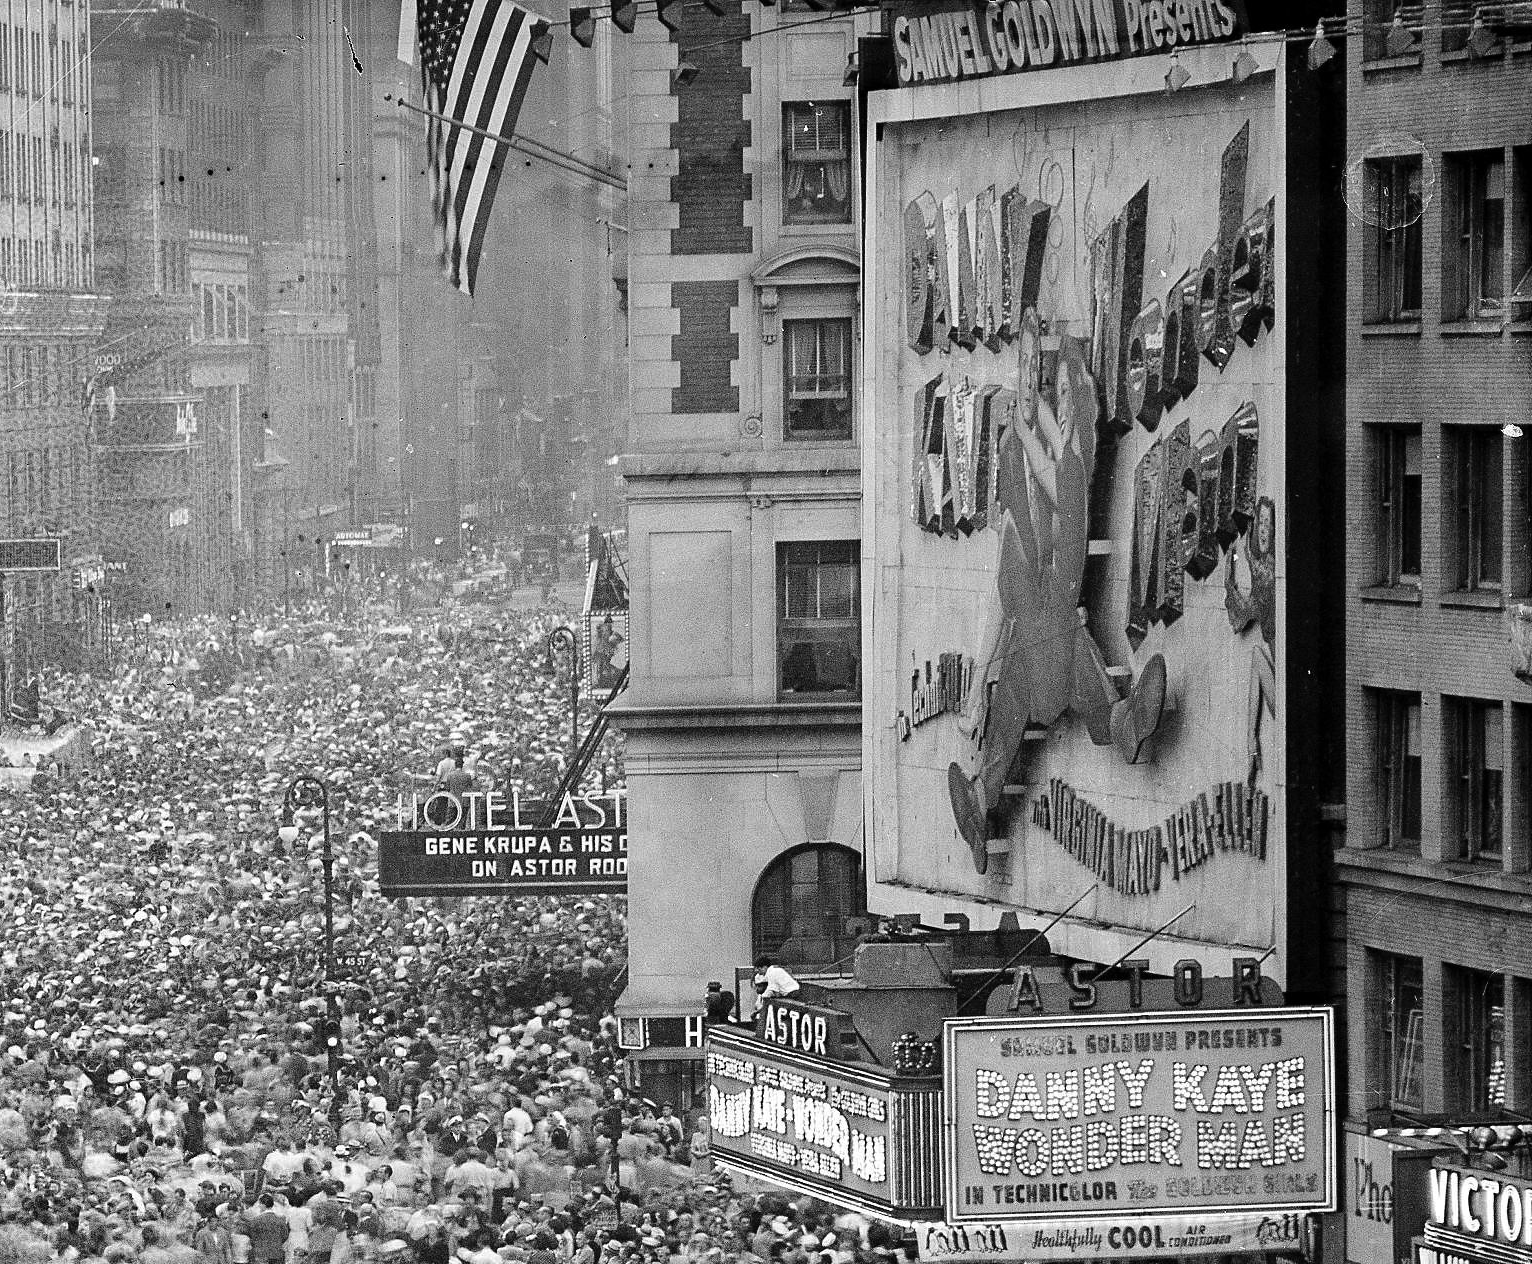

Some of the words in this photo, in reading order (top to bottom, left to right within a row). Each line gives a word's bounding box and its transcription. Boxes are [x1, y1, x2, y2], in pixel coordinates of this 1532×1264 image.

[895, 10, 993, 82] SAMUEL
[986, 0, 1119, 71] GOLDWYN
[1125, 0, 1238, 53] Presents
[904, 184, 1052, 355] DANNY
[397, 790, 533, 832] HOTEL
[426, 837, 478, 855] GENE
[484, 836, 552, 854] KRUPA
[559, 837, 573, 852] &
[581, 835, 612, 852] HIS
[1049, 777, 1114, 888] VIRGINIA
[472, 860, 497, 877] ON
[510, 859, 577, 877] ASTOR
[1011, 958, 1262, 1013] ASTOR
[764, 1004, 827, 1055] ASTOR
[1001, 1034, 1078, 1058] SAMUEL
[1084, 1030, 1178, 1055] GOLDWYN
[1185, 1027, 1283, 1051] PRESENTS
[975, 1057, 1156, 1121] DANNY
[1172, 1056, 1307, 1114] KAYE
[972, 1114, 1183, 1177] WONDER
[1197, 1112, 1307, 1170] MAN
[965, 1185, 984, 1205] IN
[993, 1180, 1118, 1205] TECHNICOLOR
[1031, 1225, 1103, 1253] Healthfully
[1107, 1224, 1166, 1249] COOL
[1167, 1234, 1232, 1247] CONDITIONED
[1184, 1225, 1207, 1235] AIR
